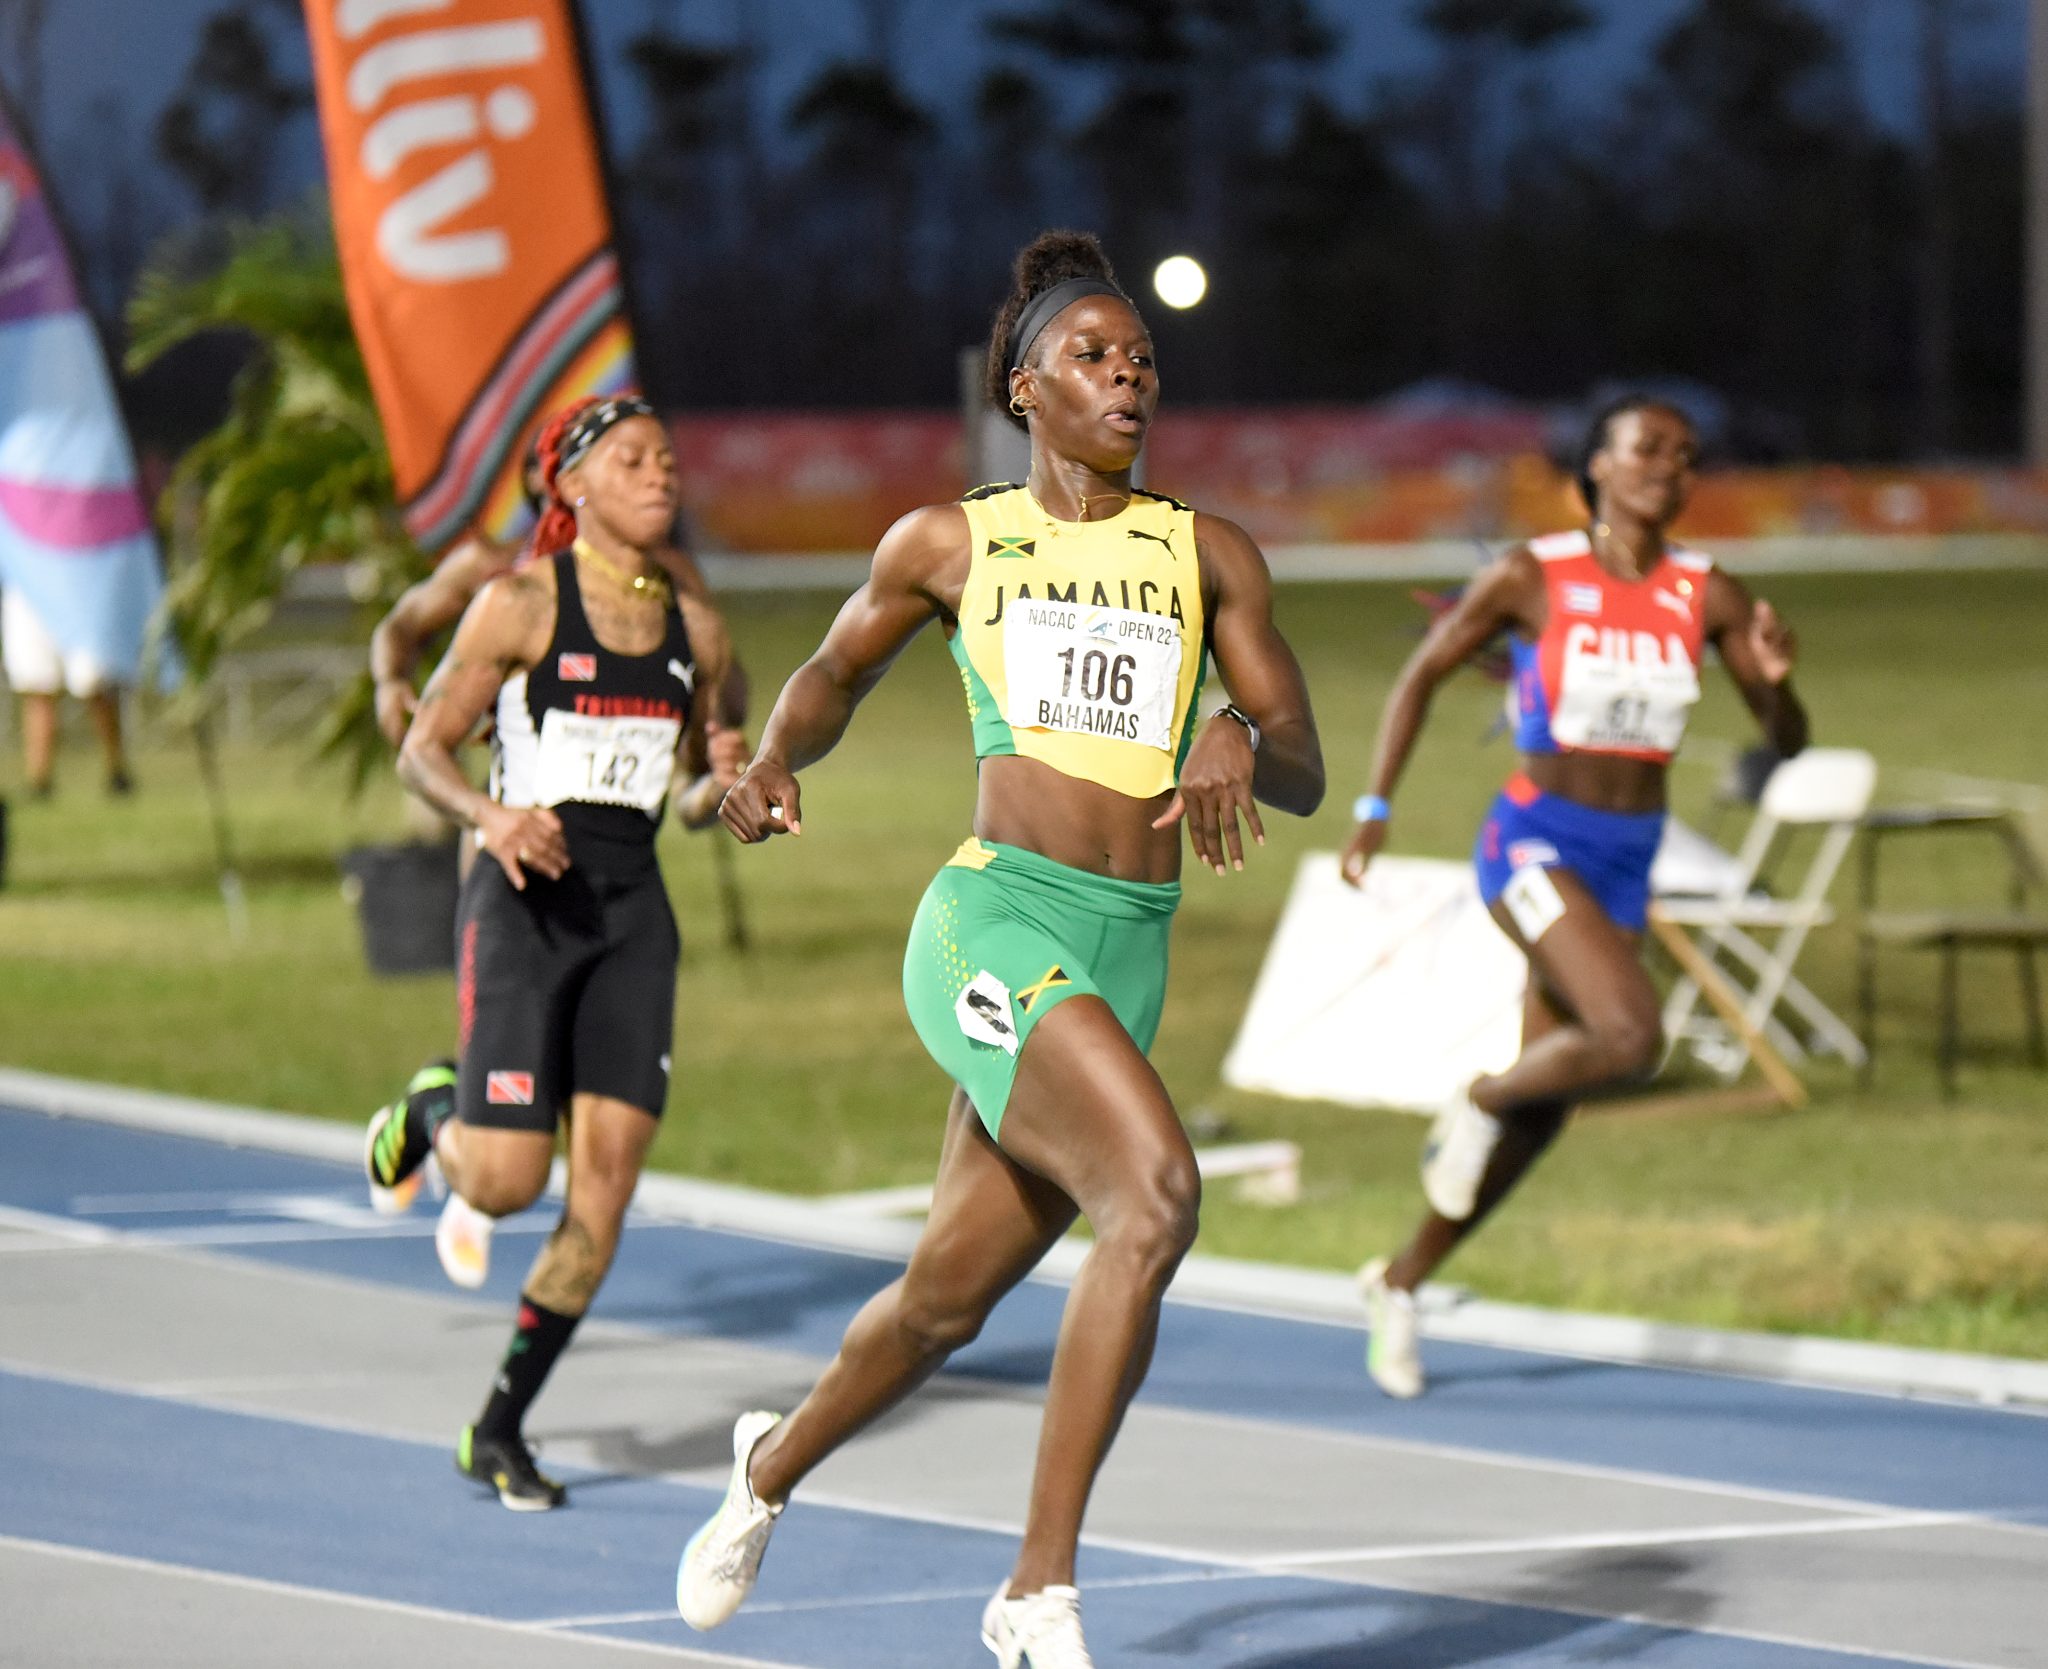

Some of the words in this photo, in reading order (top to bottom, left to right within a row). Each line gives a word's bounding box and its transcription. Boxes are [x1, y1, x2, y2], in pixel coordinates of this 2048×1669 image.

[1028, 608, 1076, 630] NACAC
[1118, 620, 1154, 641] OPEN
[1157, 626, 1172, 646] 22
[1057, 647, 1136, 706] 106
[1038, 699, 1139, 740] BAHAMAS
[584, 751, 639, 792] 142
